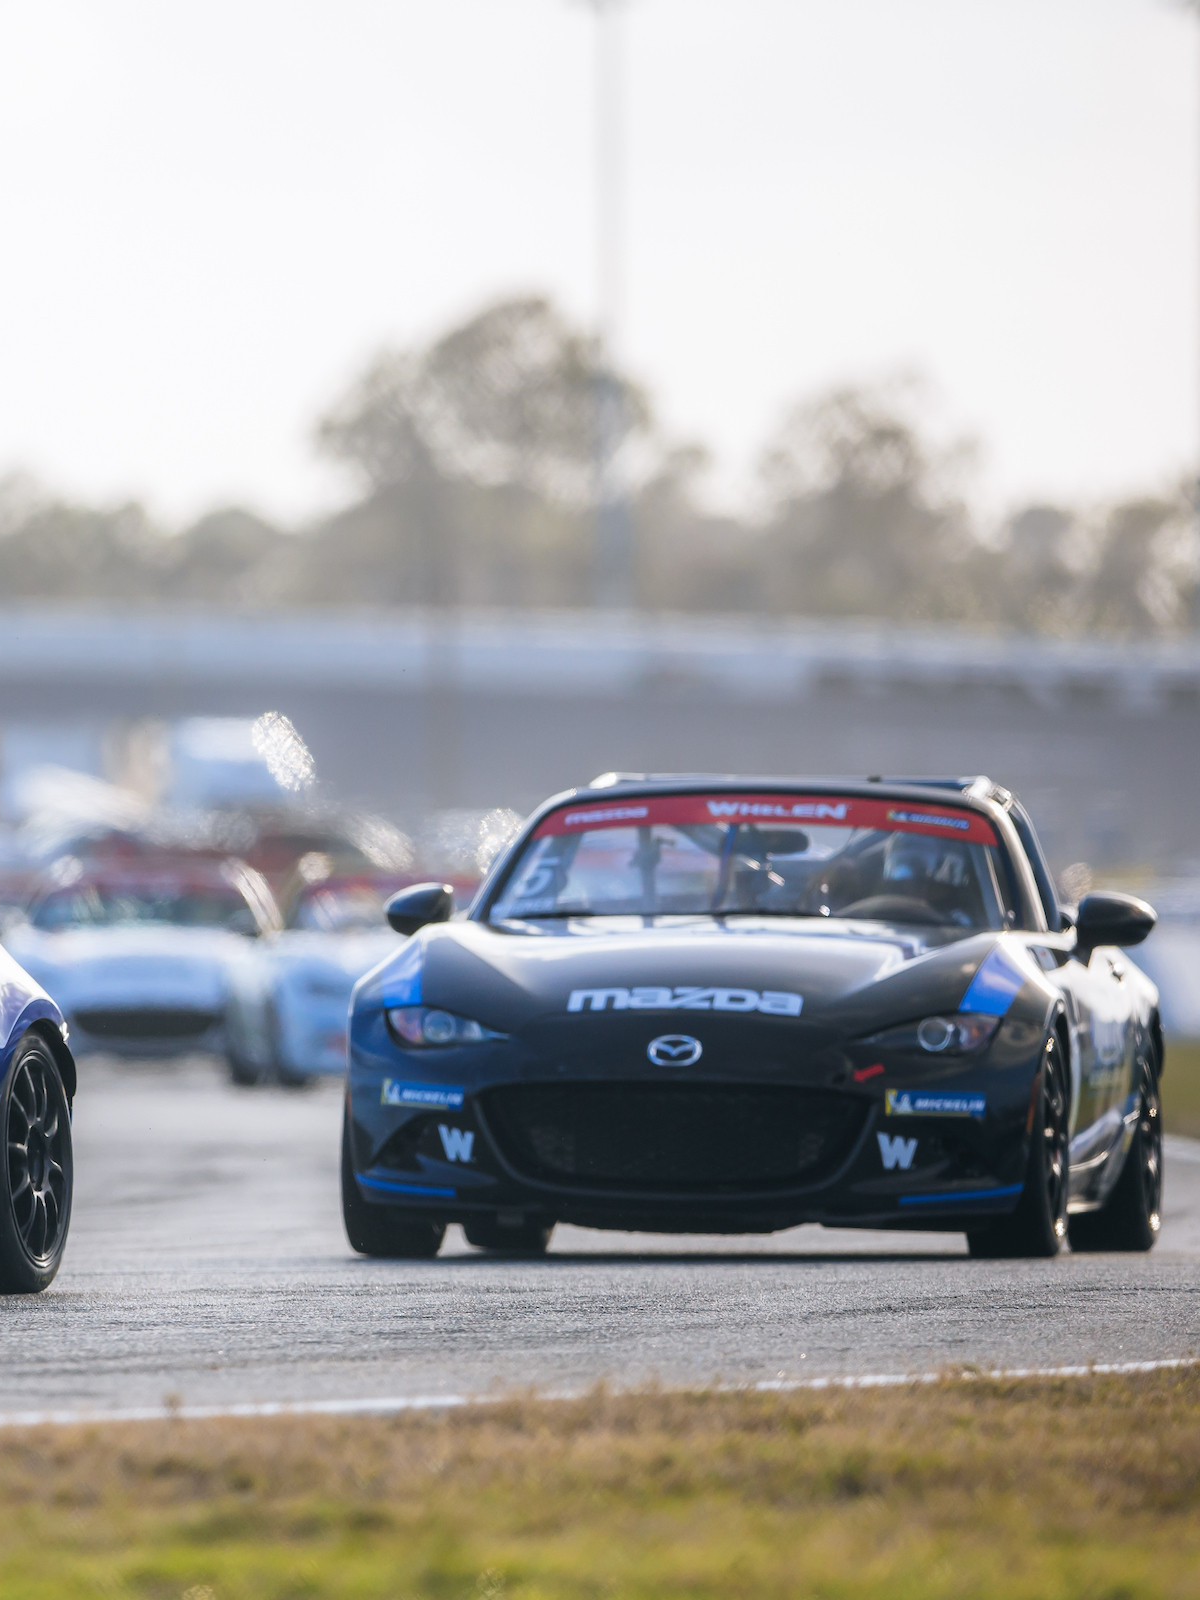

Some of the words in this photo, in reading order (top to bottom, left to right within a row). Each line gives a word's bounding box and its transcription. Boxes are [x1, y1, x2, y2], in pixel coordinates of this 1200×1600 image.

[706, 801, 849, 820] WHELEN
[437, 1123, 475, 1163] W
[876, 1131, 919, 1170] W
